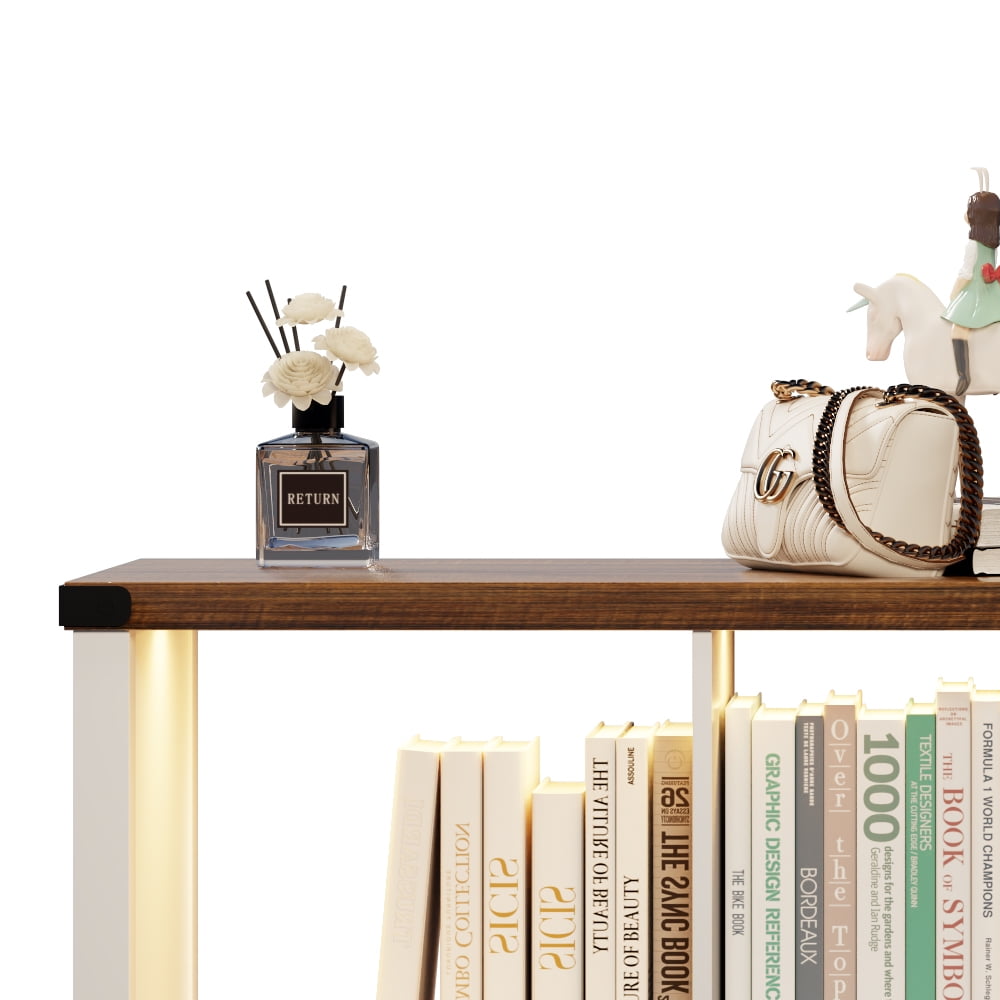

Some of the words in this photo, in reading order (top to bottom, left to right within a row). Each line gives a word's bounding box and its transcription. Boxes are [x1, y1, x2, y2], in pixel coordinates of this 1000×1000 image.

[287, 493, 340, 505] RETURN
[627, 747, 635, 786] ASSOULINE
[831, 719, 849, 807] Over
[920, 734, 932, 781] TEXTILE
[943, 753, 953, 780] THE
[983, 722, 993, 783] FORMULA
[765, 753, 781, 832] GRAPHIC
[863, 733, 900, 842] 1000
[920, 785, 932, 852] DESIGNERS
[943, 787, 965, 868] BOOK
[983, 796, 993, 842] WORLD
[732, 869, 745, 886] THE
[765, 838, 781, 902] DESIGN
[833, 837, 847, 901] the
[870, 847, 880, 889] Geraldine
[882, 846, 894, 880] designs
[732, 890, 745, 910] BIKE
[870, 890, 880, 907] and
[884, 882, 894, 894] for
[943, 874, 953, 892] OF
[982, 845, 993, 919] CHAMPIONS
[624, 875, 639, 941] BEAUTY
[800, 868, 818, 965] BORDEAUX
[870, 909, 880, 923] Ian
[884, 897, 894, 912] the
[732, 913, 745, 936] BOOK
[868, 924, 880, 952] Rudge
[882, 914, 894, 949] gardens
[624, 945, 640, 967] OF
[832, 925, 848, 1000] Top
[884, 951, 894, 967] and
[884, 969, 894, 997] where
